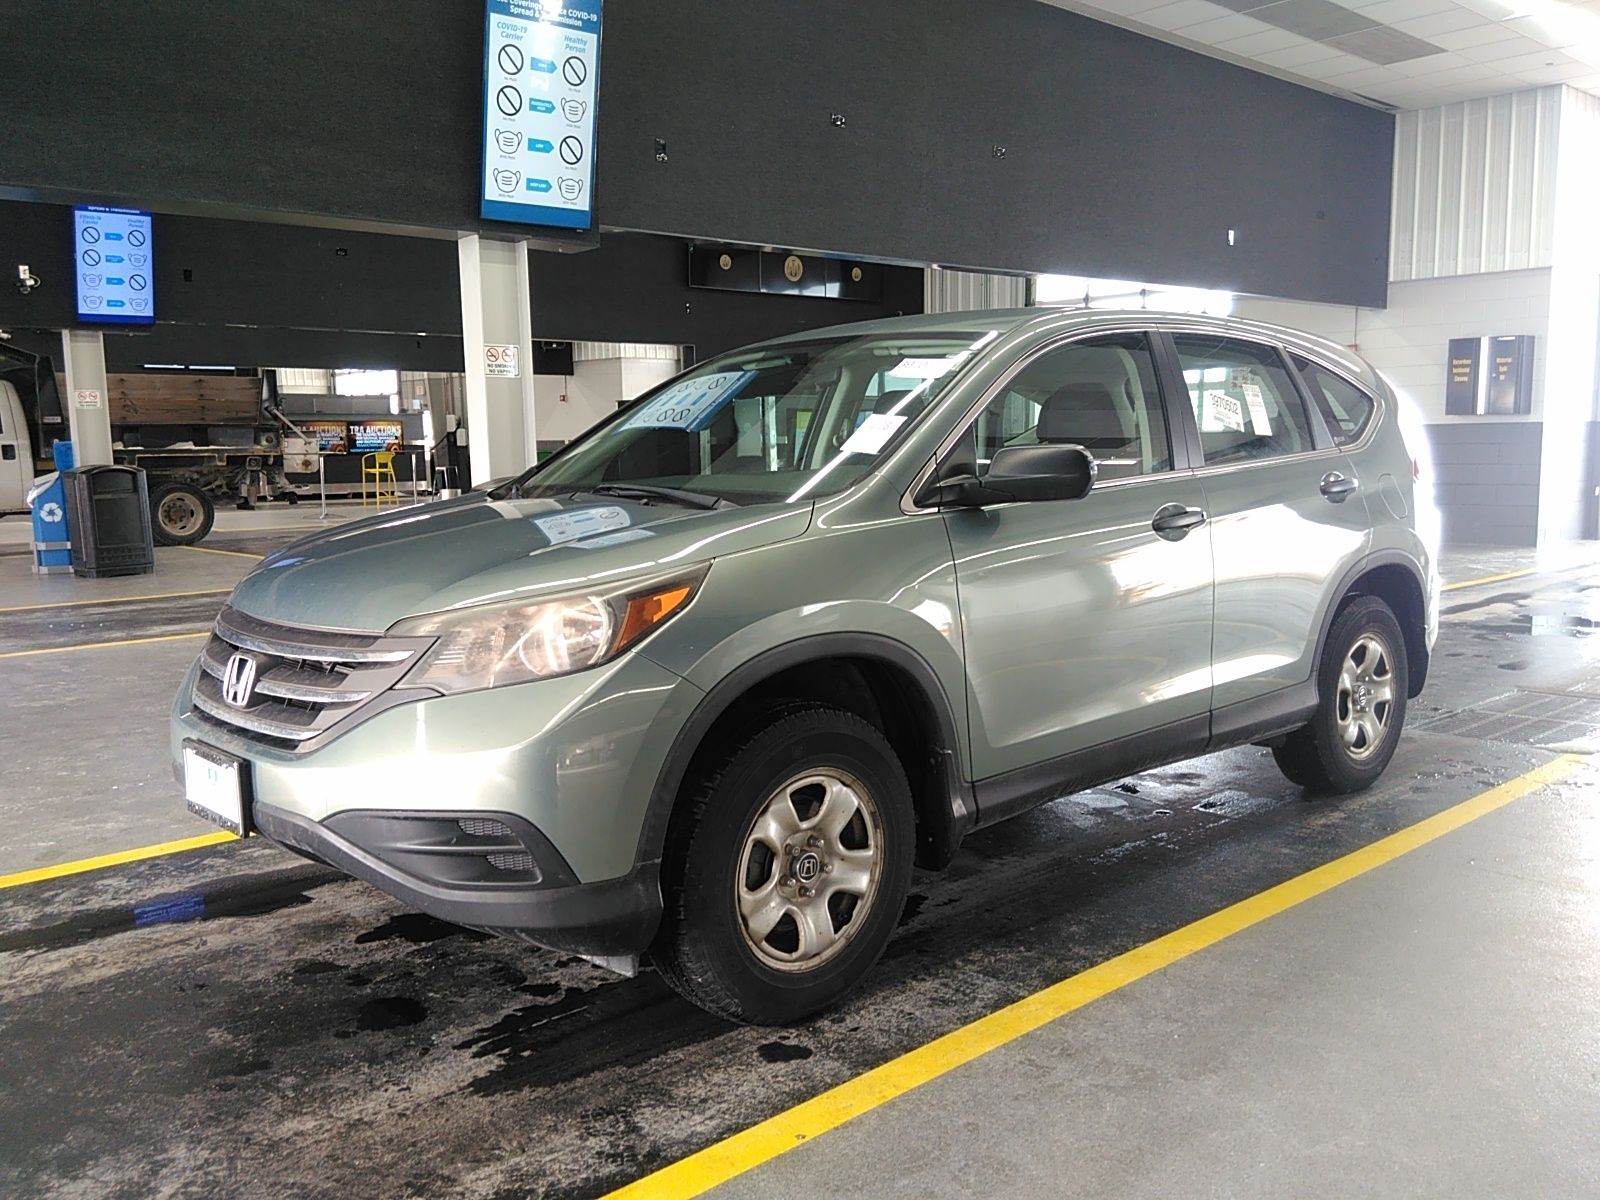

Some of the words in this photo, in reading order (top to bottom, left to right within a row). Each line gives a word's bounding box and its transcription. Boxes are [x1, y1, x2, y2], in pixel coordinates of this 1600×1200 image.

[510, 5, 534, 17] Spread
[568, 9, 597, 22] COVID-19
[496, 21, 528, 34] COVID-19
[500, 30, 523, 41] Carrier
[564, 35, 588, 47] Healthy
[565, 44, 586, 54] Person
[349, 425, 364, 434] TRA
[365, 425, 401, 436] AUCTIONS
